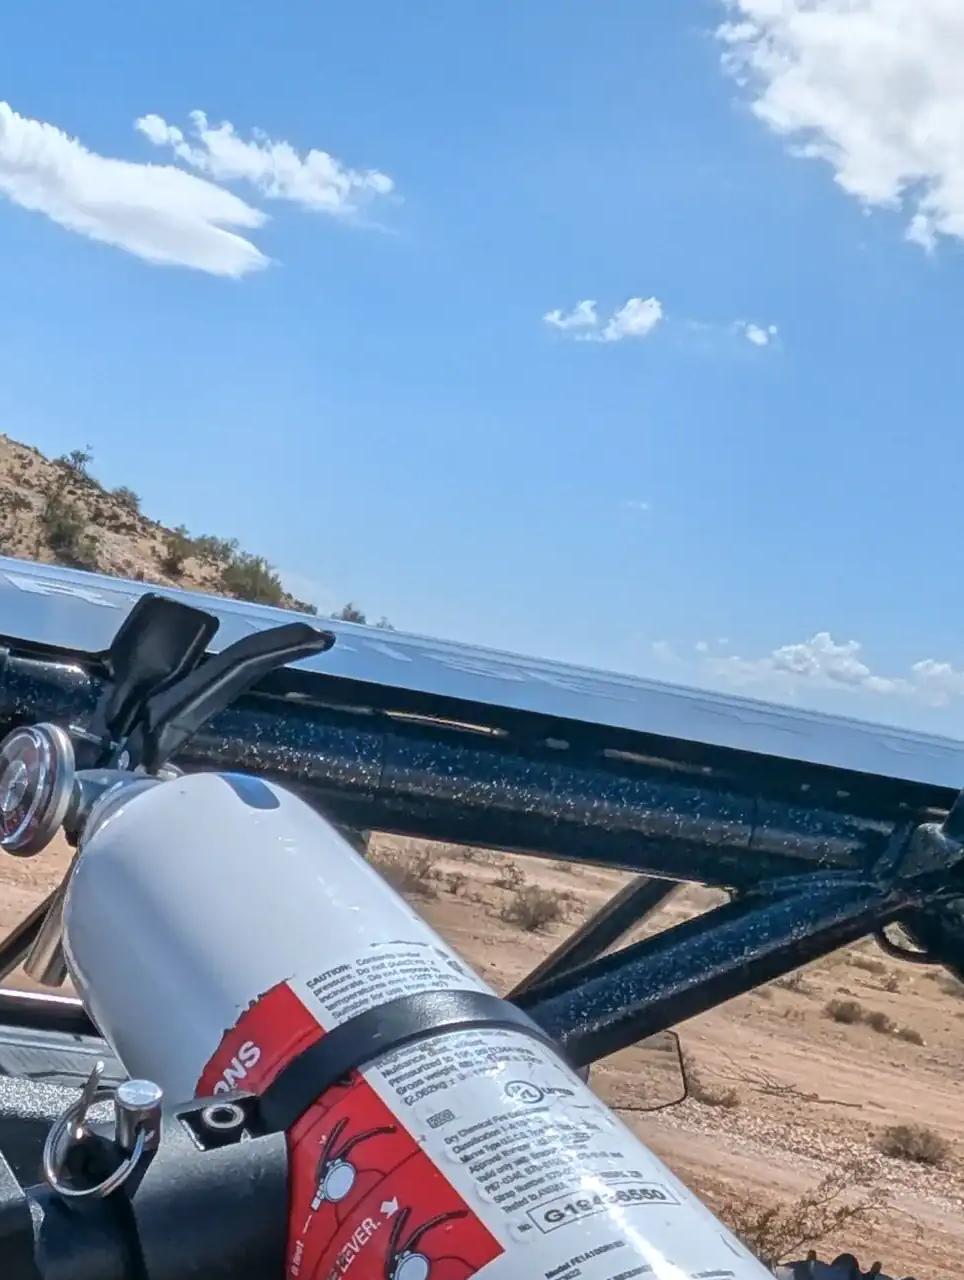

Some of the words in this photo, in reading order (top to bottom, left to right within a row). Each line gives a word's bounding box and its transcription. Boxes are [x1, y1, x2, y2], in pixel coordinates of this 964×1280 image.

[305, 963, 351, 987] CAUTION:
[325, 982, 386, 1011] temperatures
[335, 1215, 381, 1273] LEVER.
[544, 1262, 570, 1279] Model
